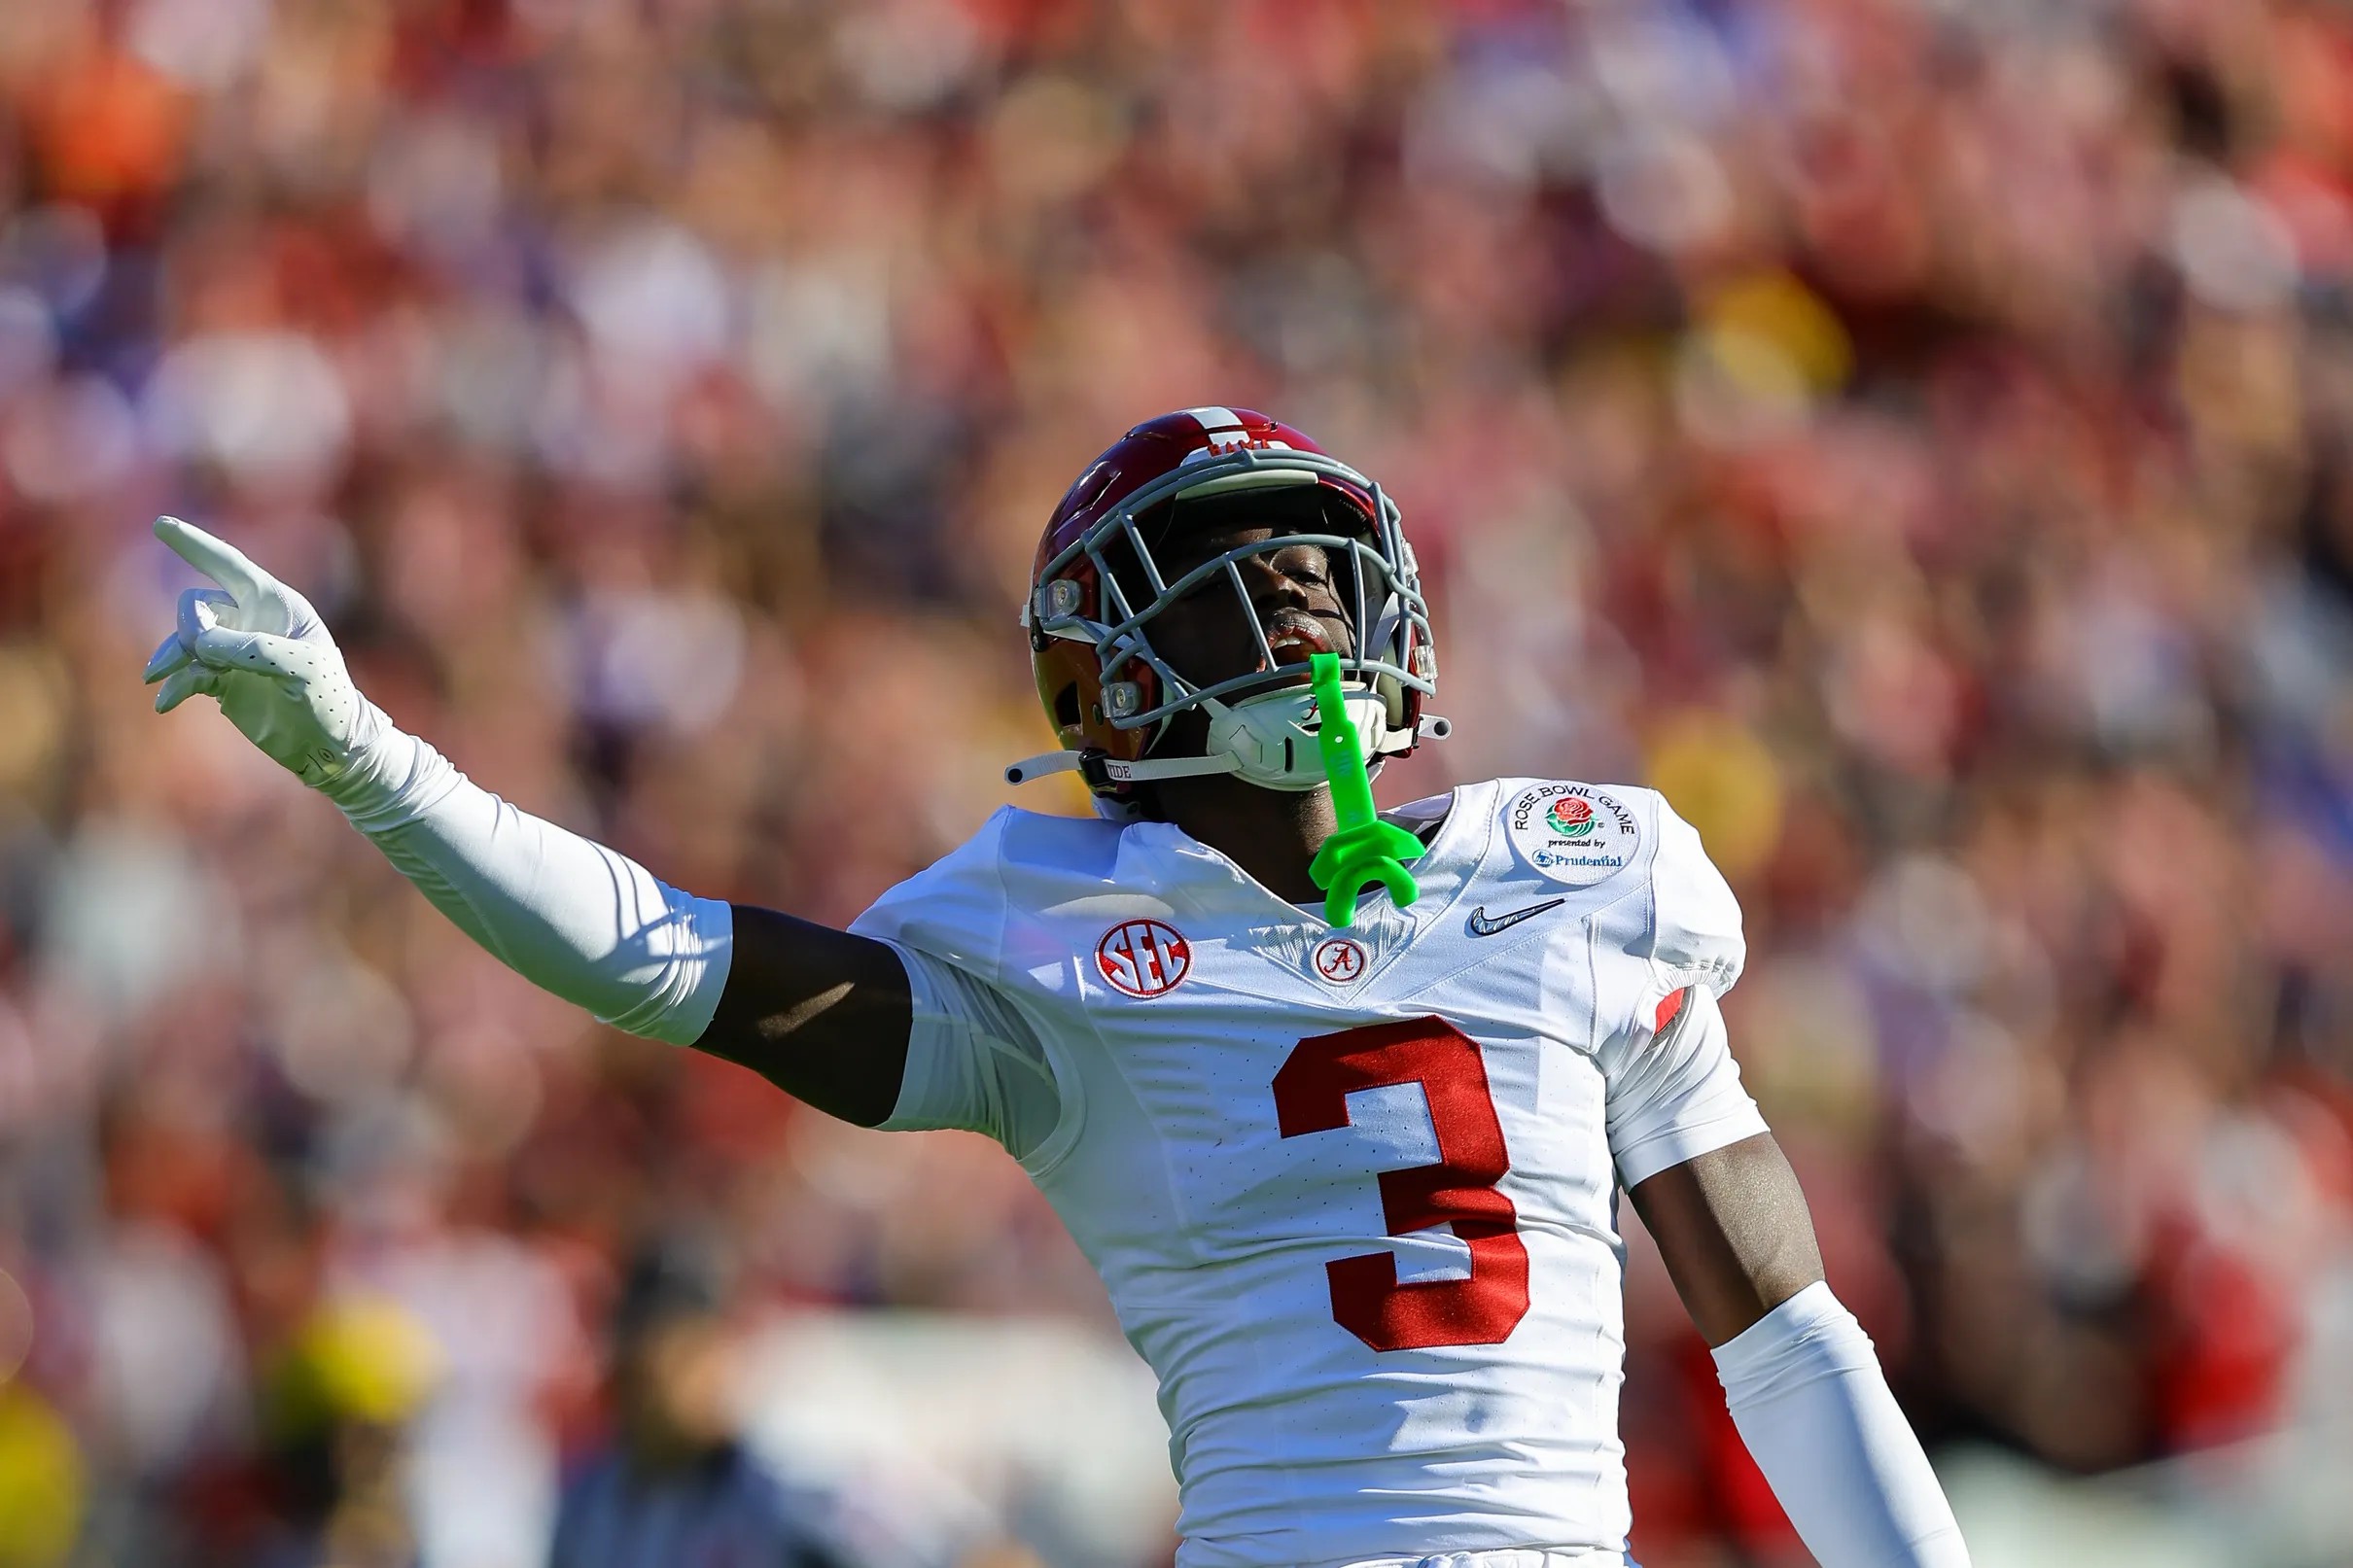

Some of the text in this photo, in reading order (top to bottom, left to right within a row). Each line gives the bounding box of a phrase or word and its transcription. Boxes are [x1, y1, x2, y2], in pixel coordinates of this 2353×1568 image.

[1208, 438, 1271, 457] BAMA
[1107, 764, 1132, 779] TIDE
[1515, 785, 1634, 834] ROSE BOWL GAME
[1548, 839, 1605, 849] presented by
[1556, 855, 1622, 867] Prudential
[1103, 923, 1186, 992] SEC
[1323, 946, 1354, 974] A
[1272, 1014, 1530, 1353] 3
